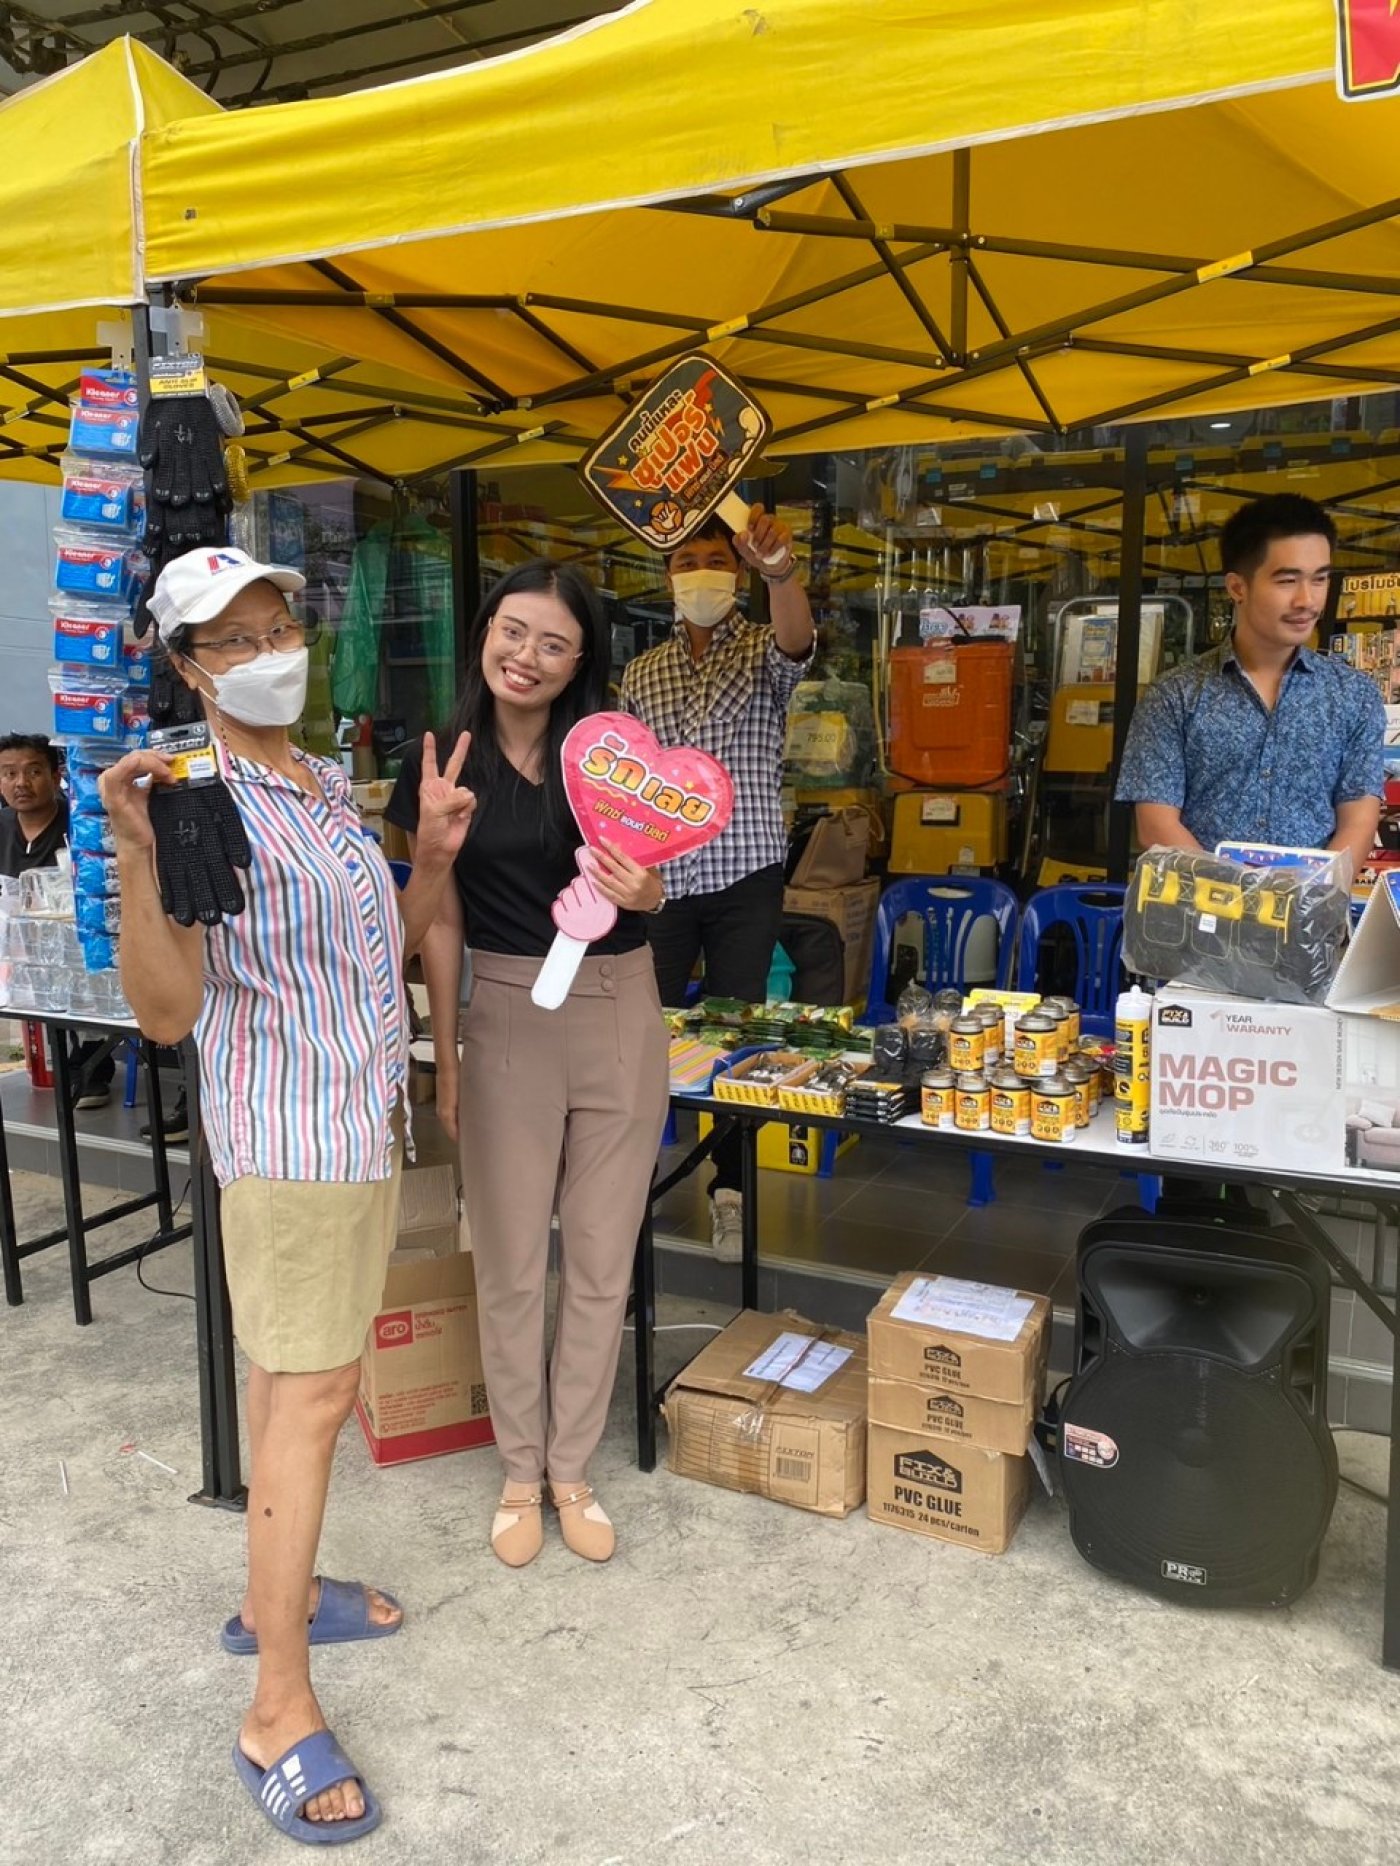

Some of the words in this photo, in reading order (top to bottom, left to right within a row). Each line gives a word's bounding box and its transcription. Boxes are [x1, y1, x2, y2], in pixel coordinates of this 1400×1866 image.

[663, 429, 718, 492] แฟน
[578, 731, 716, 828] รักเลย
[1225, 1013, 1253, 1024] YEAR
[1158, 1053, 1298, 1087] MAGIC
[1158, 1081, 1255, 1111] MOP
[383, 1323, 406, 1336] aro
[894, 1485, 923, 1507] PVC
[926, 1493, 962, 1518] GLUE
[918, 1511, 928, 1523] 24
